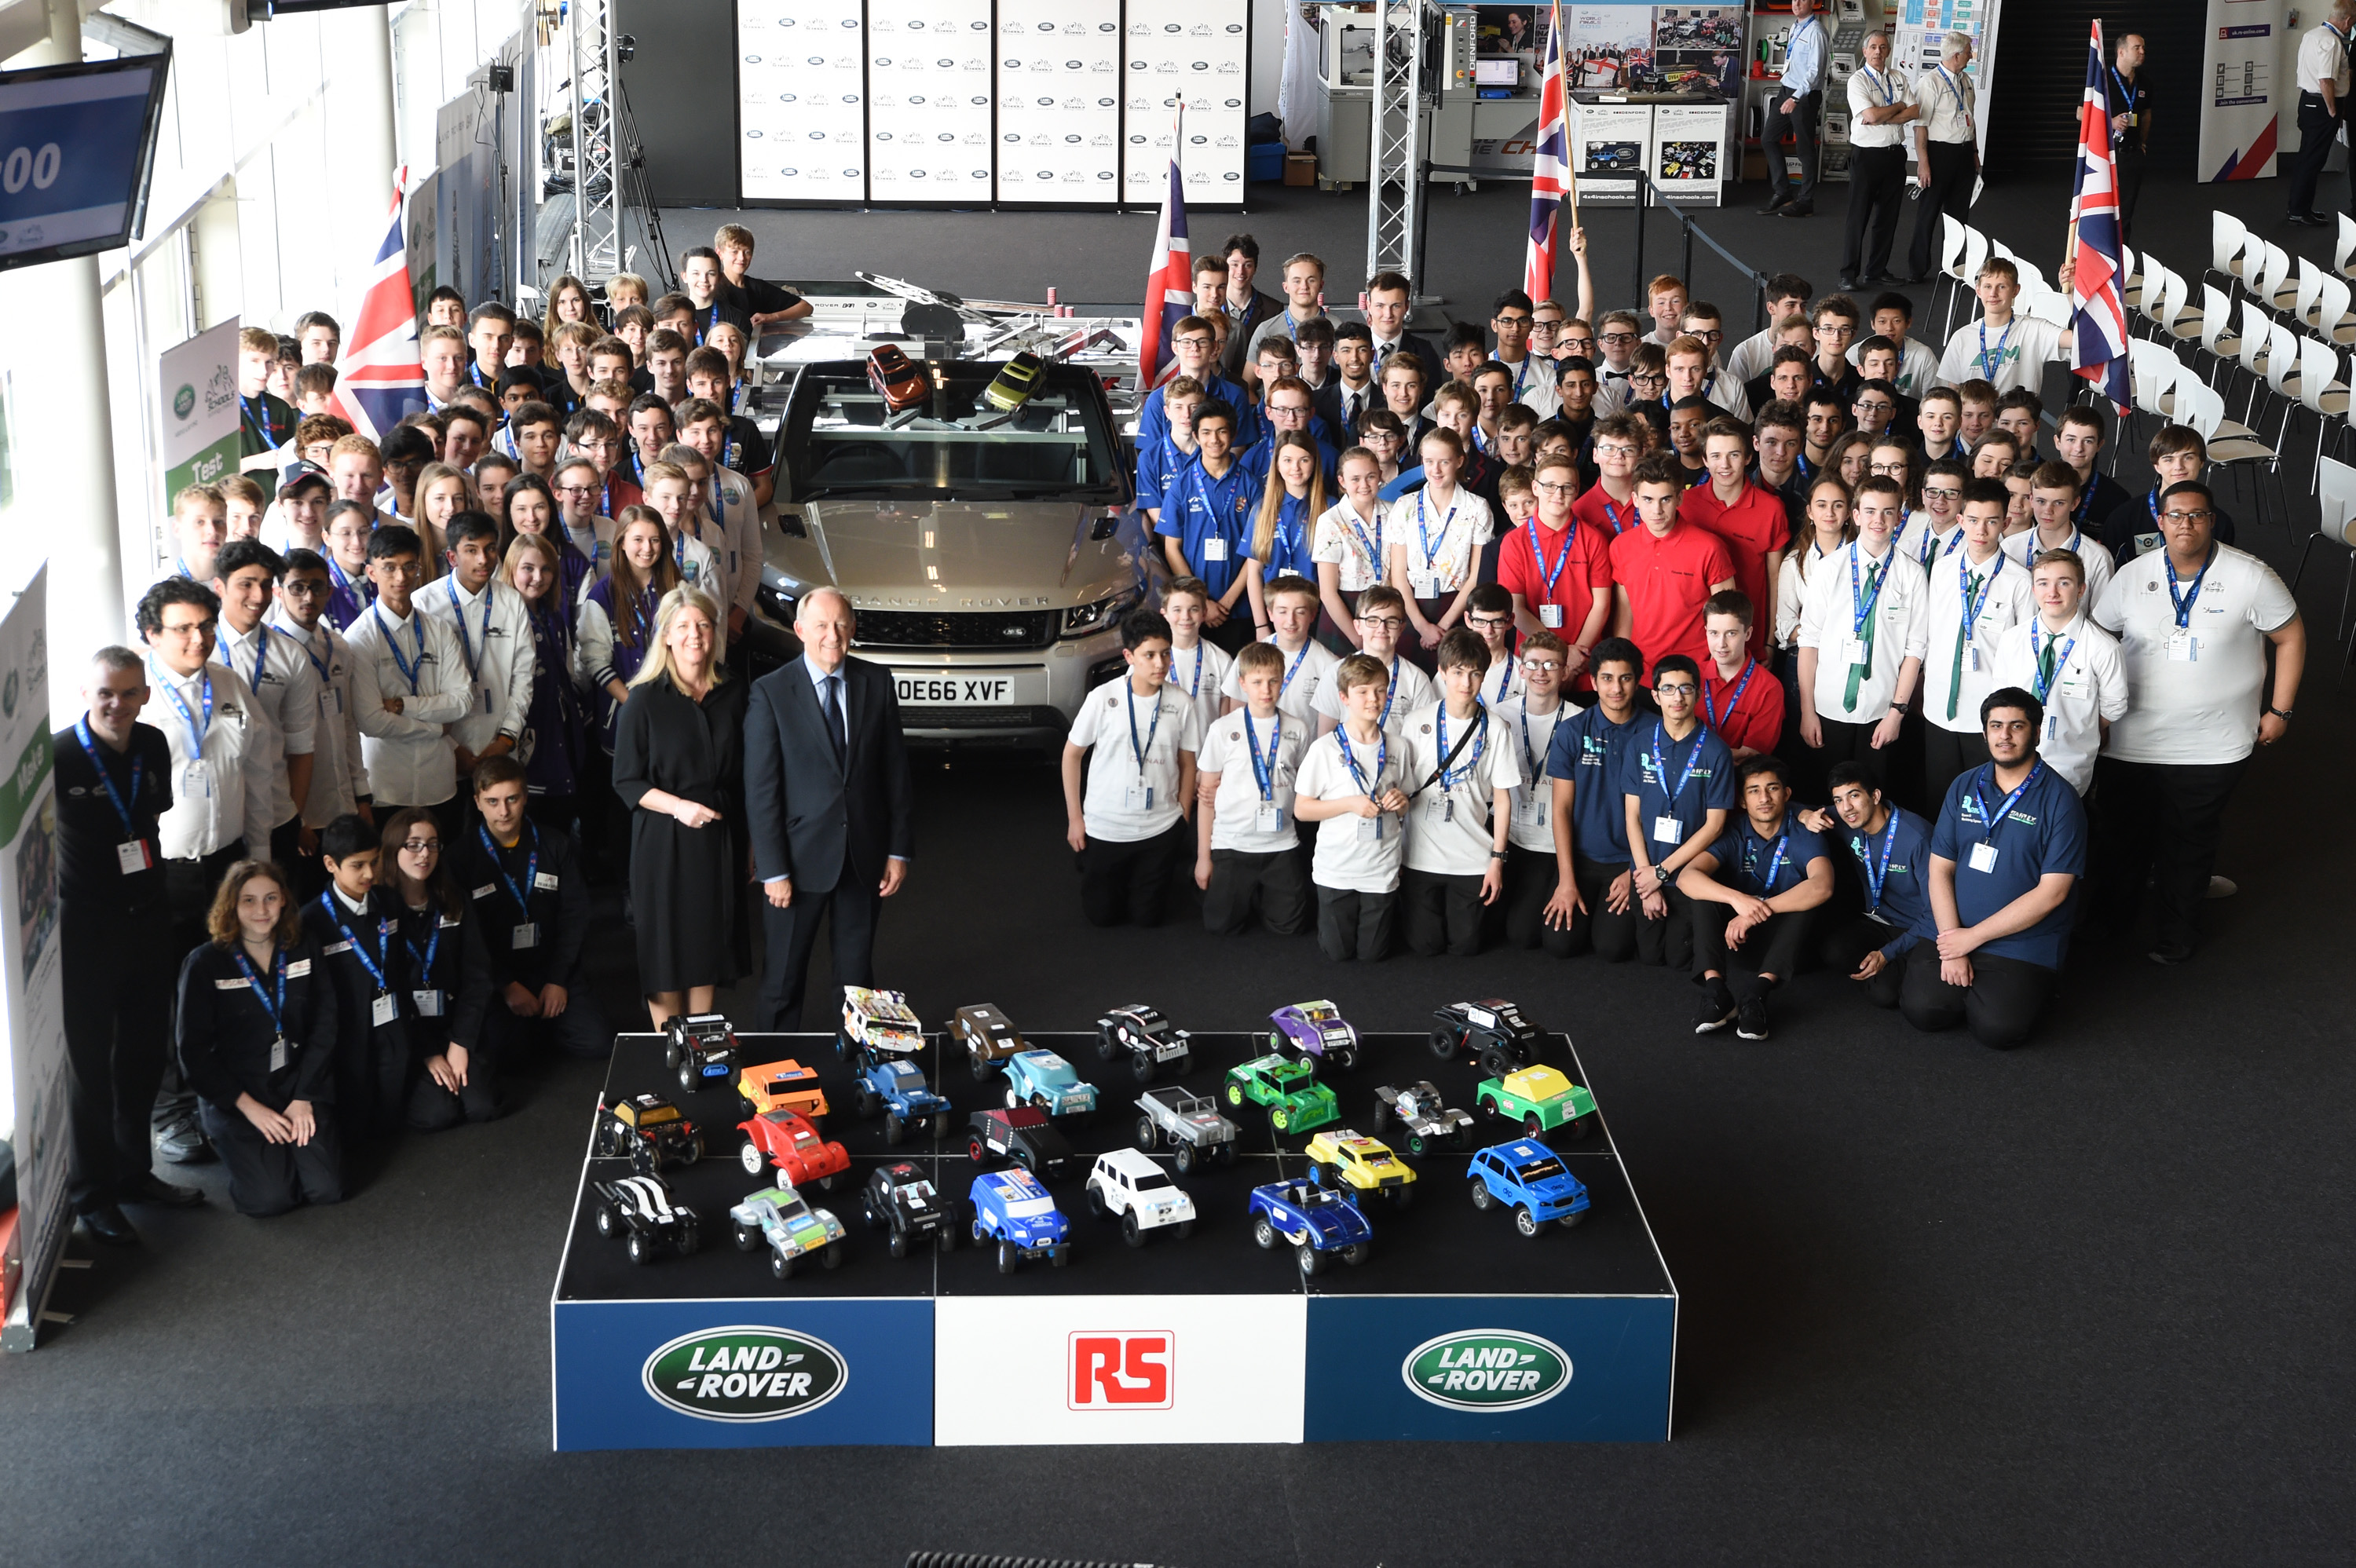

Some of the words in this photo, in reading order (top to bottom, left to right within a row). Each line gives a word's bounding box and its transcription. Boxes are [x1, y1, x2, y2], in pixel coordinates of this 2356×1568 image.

[192, 452, 224, 484] Test
[960, 596, 1048, 606] ROVER
[898, 681, 957, 700] OE66
[964, 681, 1008, 700] XVF
[1502, 1186, 1513, 1198] drp
[688, 1346, 782, 1371] LAND
[1439, 1347, 1517, 1369] LAND
[1076, 1339, 1165, 1403] RS
[1444, 1370, 1540, 1391] ROVER
[697, 1372, 812, 1398] ROVER
